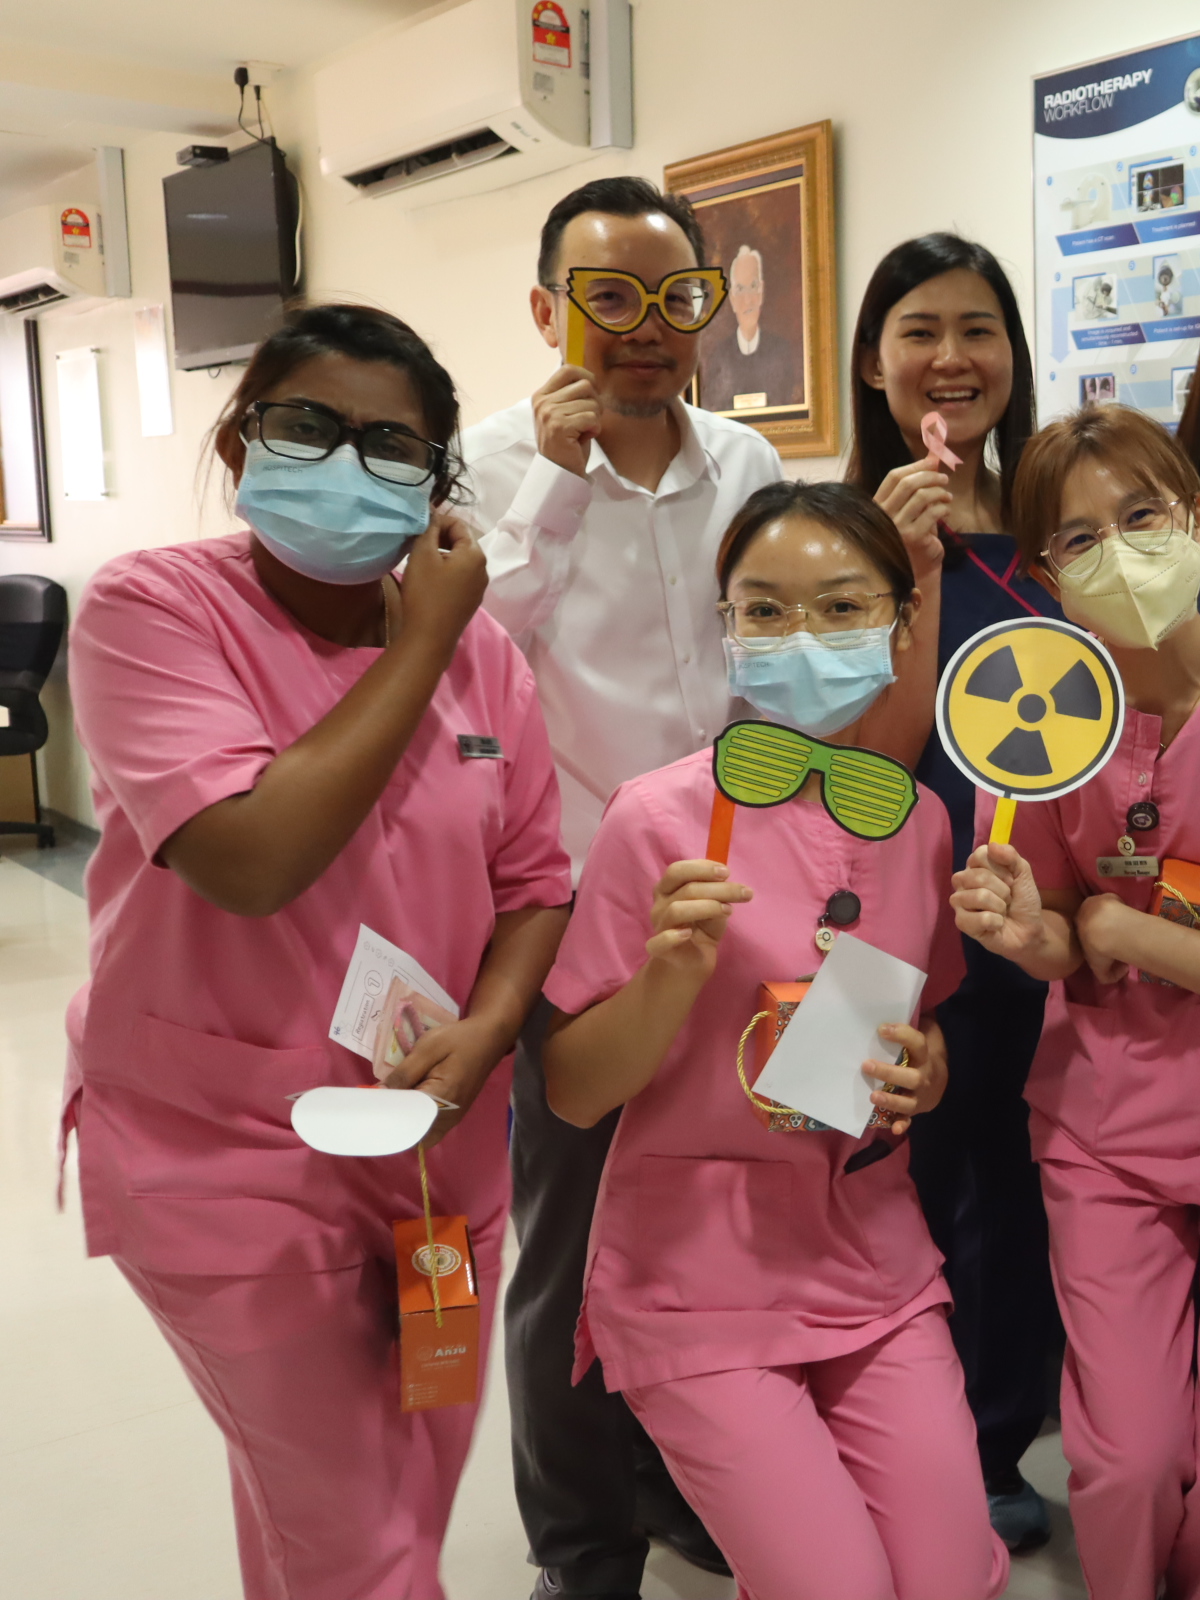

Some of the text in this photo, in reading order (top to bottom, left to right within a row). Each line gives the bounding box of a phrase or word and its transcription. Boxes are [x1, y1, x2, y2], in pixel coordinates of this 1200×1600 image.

[1044, 68, 1153, 109] RADIOTHERAPY
[1044, 92, 1115, 123] WORKFLOW
[356, 1000, 371, 1035] Registration
